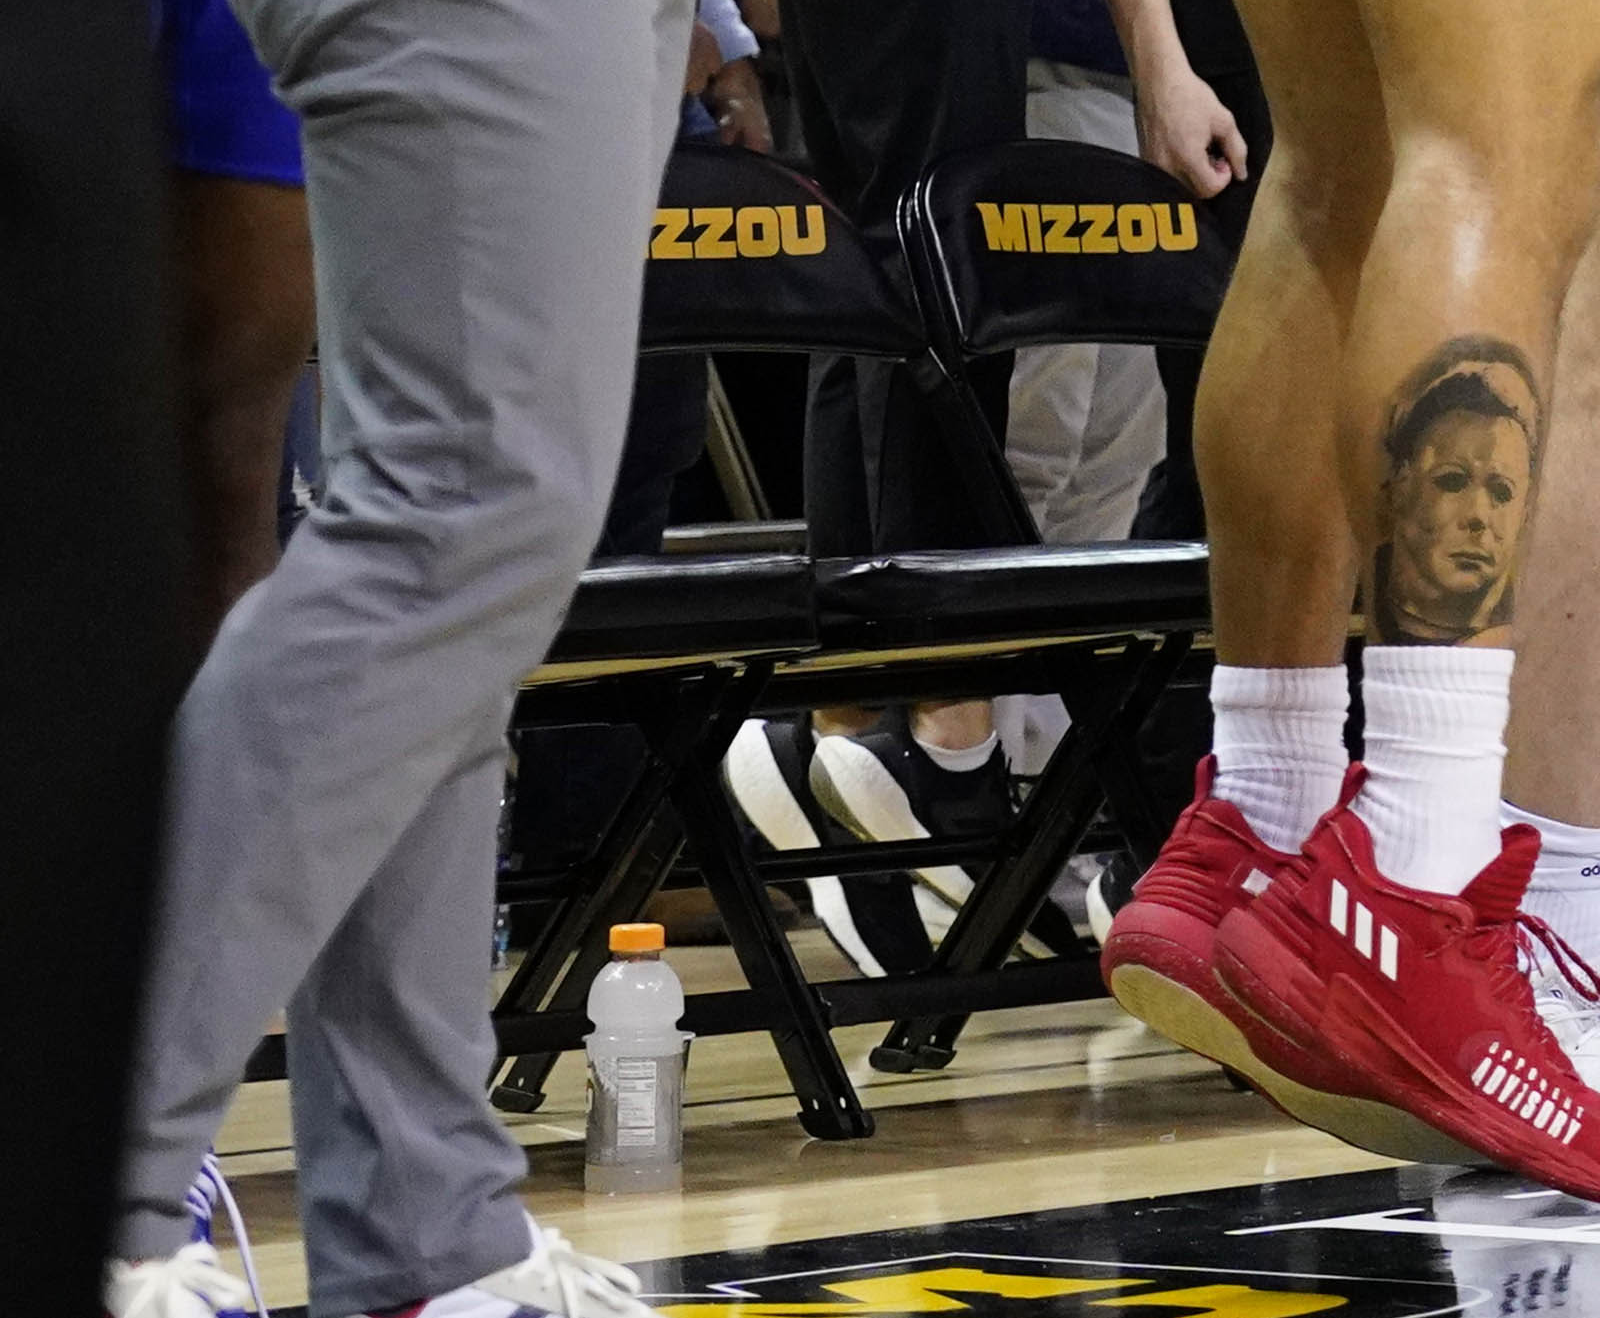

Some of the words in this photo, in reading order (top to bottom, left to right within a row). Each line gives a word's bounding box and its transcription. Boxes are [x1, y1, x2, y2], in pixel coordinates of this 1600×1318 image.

[645, 204, 827, 259] ZZOU
[976, 202, 1199, 254] MIZZOU
[1470, 1056, 1582, 1145] ADVISORY
